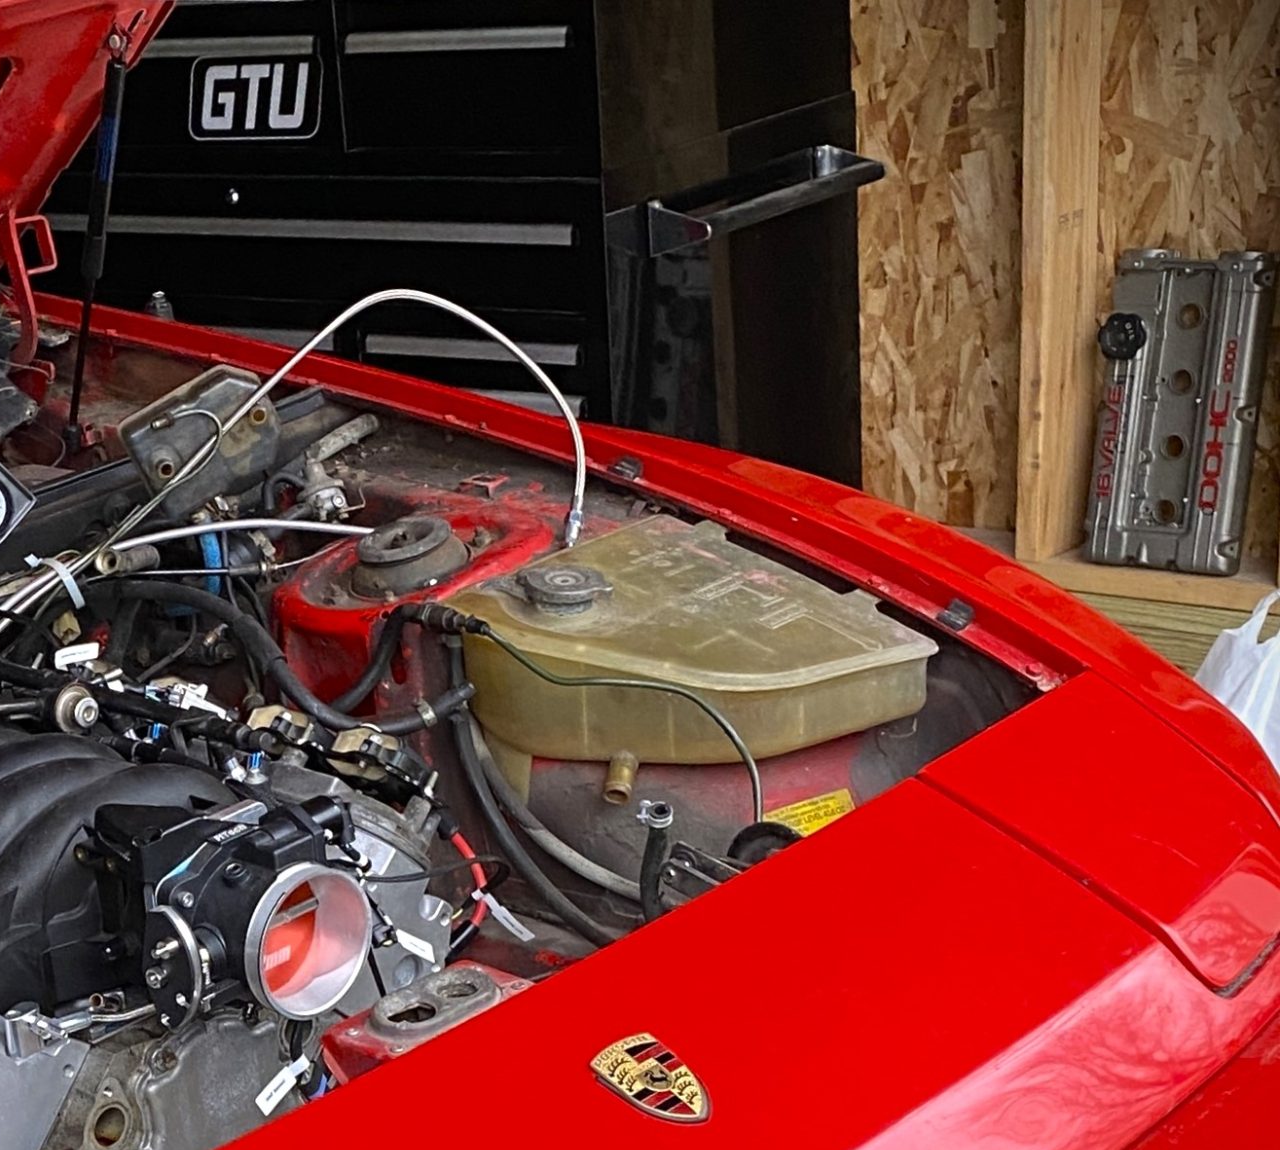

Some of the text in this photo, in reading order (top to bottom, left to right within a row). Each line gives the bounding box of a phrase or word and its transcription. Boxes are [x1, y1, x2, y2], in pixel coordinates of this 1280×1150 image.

[201, 62, 309, 130] GTU
[1099, 385, 1125, 471] VALVE
[1198, 339, 1238, 509] DOHC 2000
